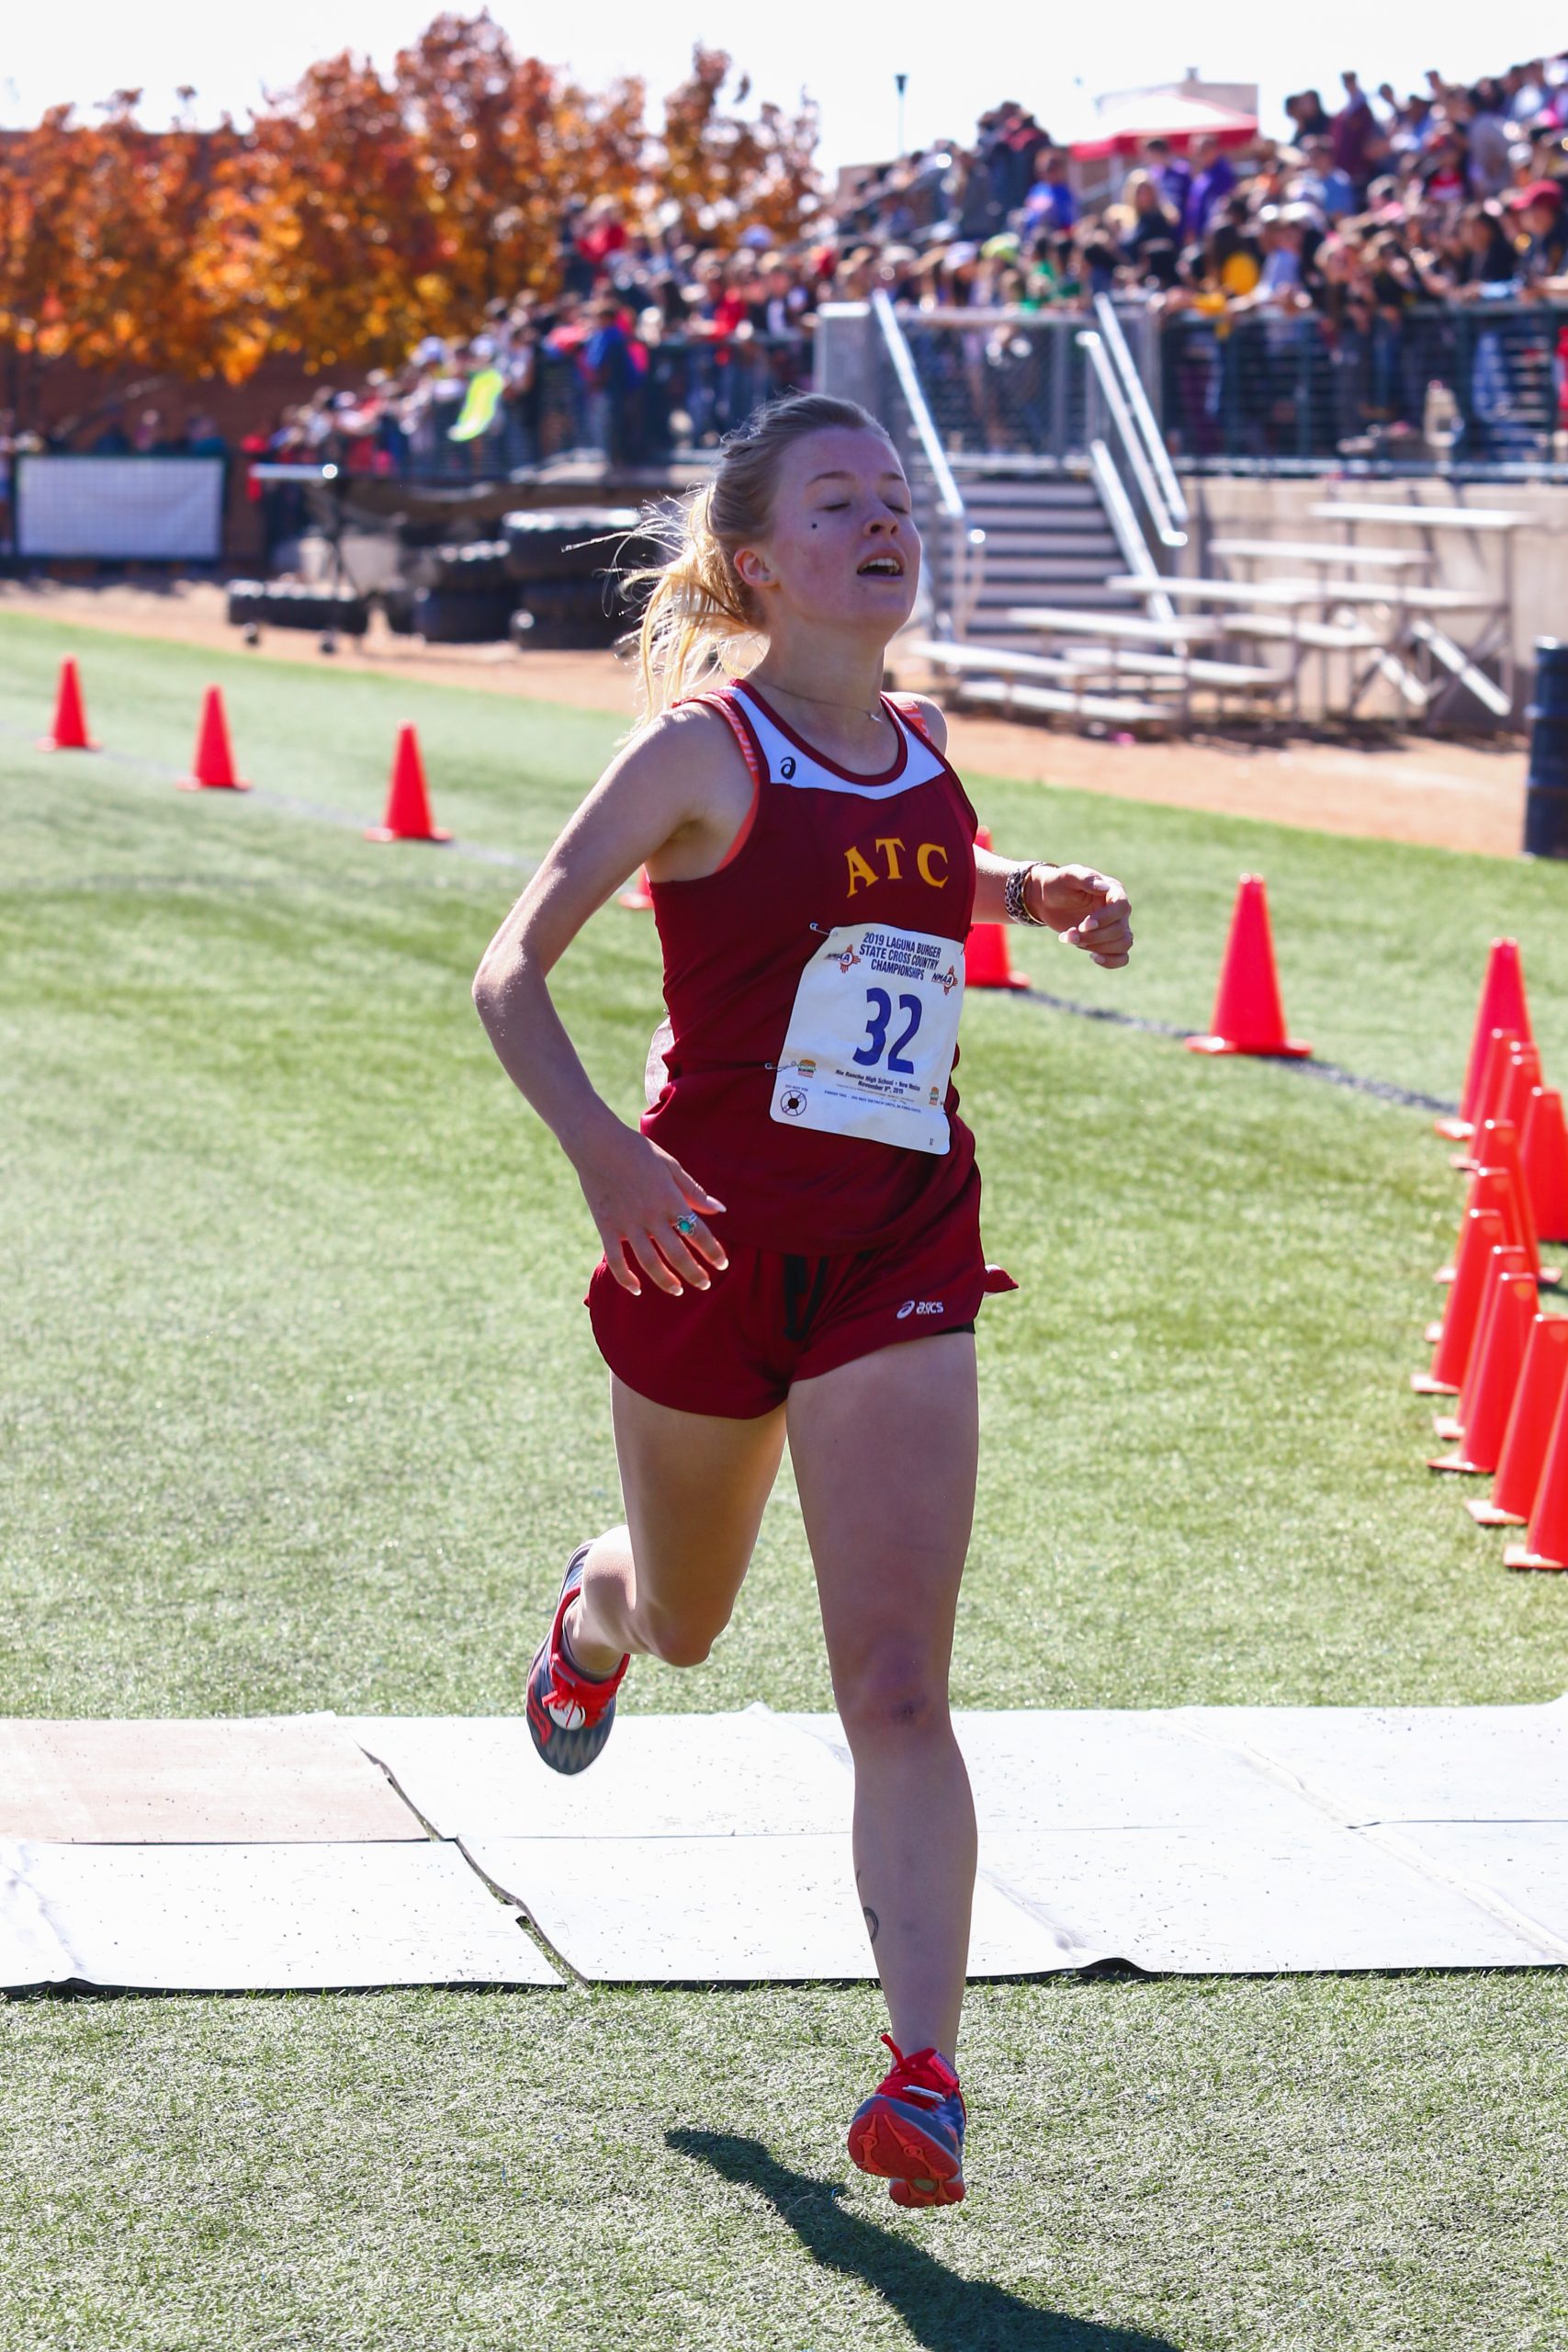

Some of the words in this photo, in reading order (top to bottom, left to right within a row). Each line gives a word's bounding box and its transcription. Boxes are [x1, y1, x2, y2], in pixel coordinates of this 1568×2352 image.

[844, 837, 949, 898] ATC
[859, 944, 886, 960] STATE
[888, 950, 911, 964] CROSS
[911, 954, 940, 970] COUNTRY
[863, 932, 885, 946] 2019
[886, 936, 915, 952] LAGUNA
[917, 943, 942, 958] BURGER
[871, 958, 924, 981] CHAMPIONSHIPS
[931, 973, 953, 984] NMAA
[852, 987, 923, 1074] 32
[858, 1080, 883, 1091] November
[865, 1075, 876, 1083] High
[877, 1077, 894, 1086] School
